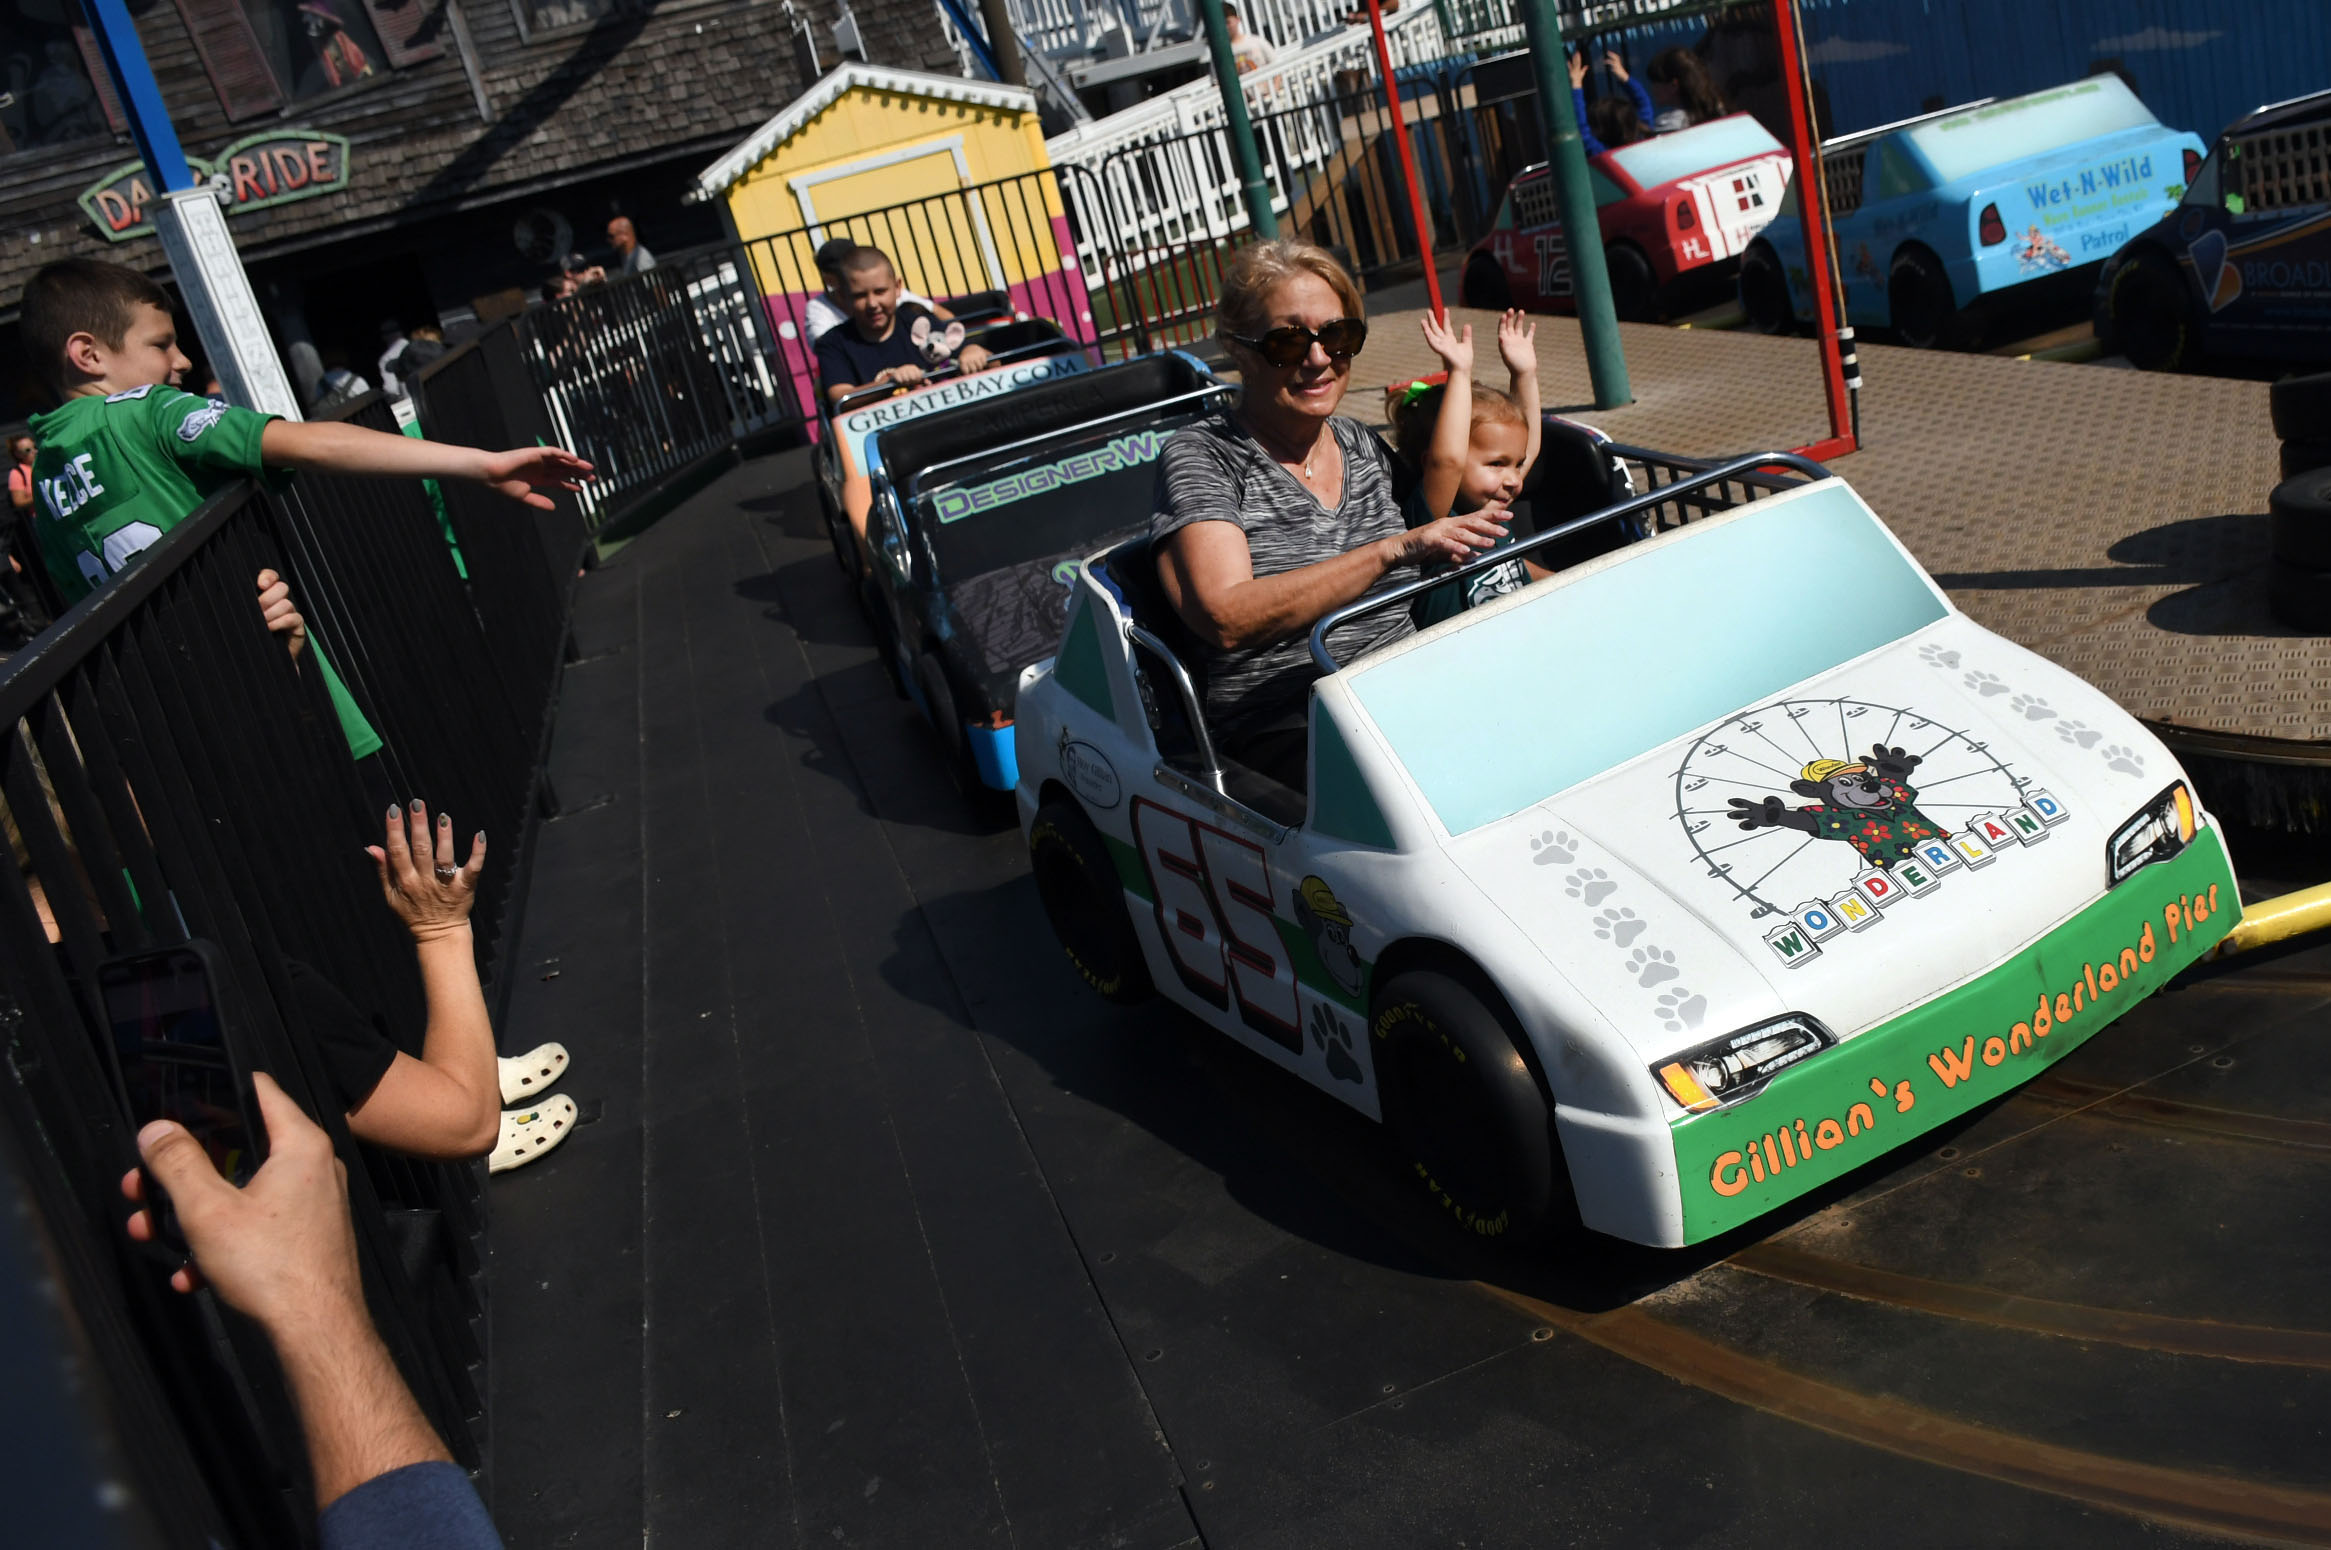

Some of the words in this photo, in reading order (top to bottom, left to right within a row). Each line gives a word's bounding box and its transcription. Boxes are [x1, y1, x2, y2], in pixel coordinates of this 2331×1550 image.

[230, 141, 334, 202] RIDE
[2026, 156, 2153, 209] Wet-N-Wild
[2081, 223, 2130, 251] Patrol
[1130, 795, 1304, 1056] 65
[1772, 797, 2058, 958] WONDERLAND
[1709, 1077, 1915, 1197] Gillian's
[1927, 921, 2156, 1089] Wonderland
[2164, 883, 2218, 943] Pier
